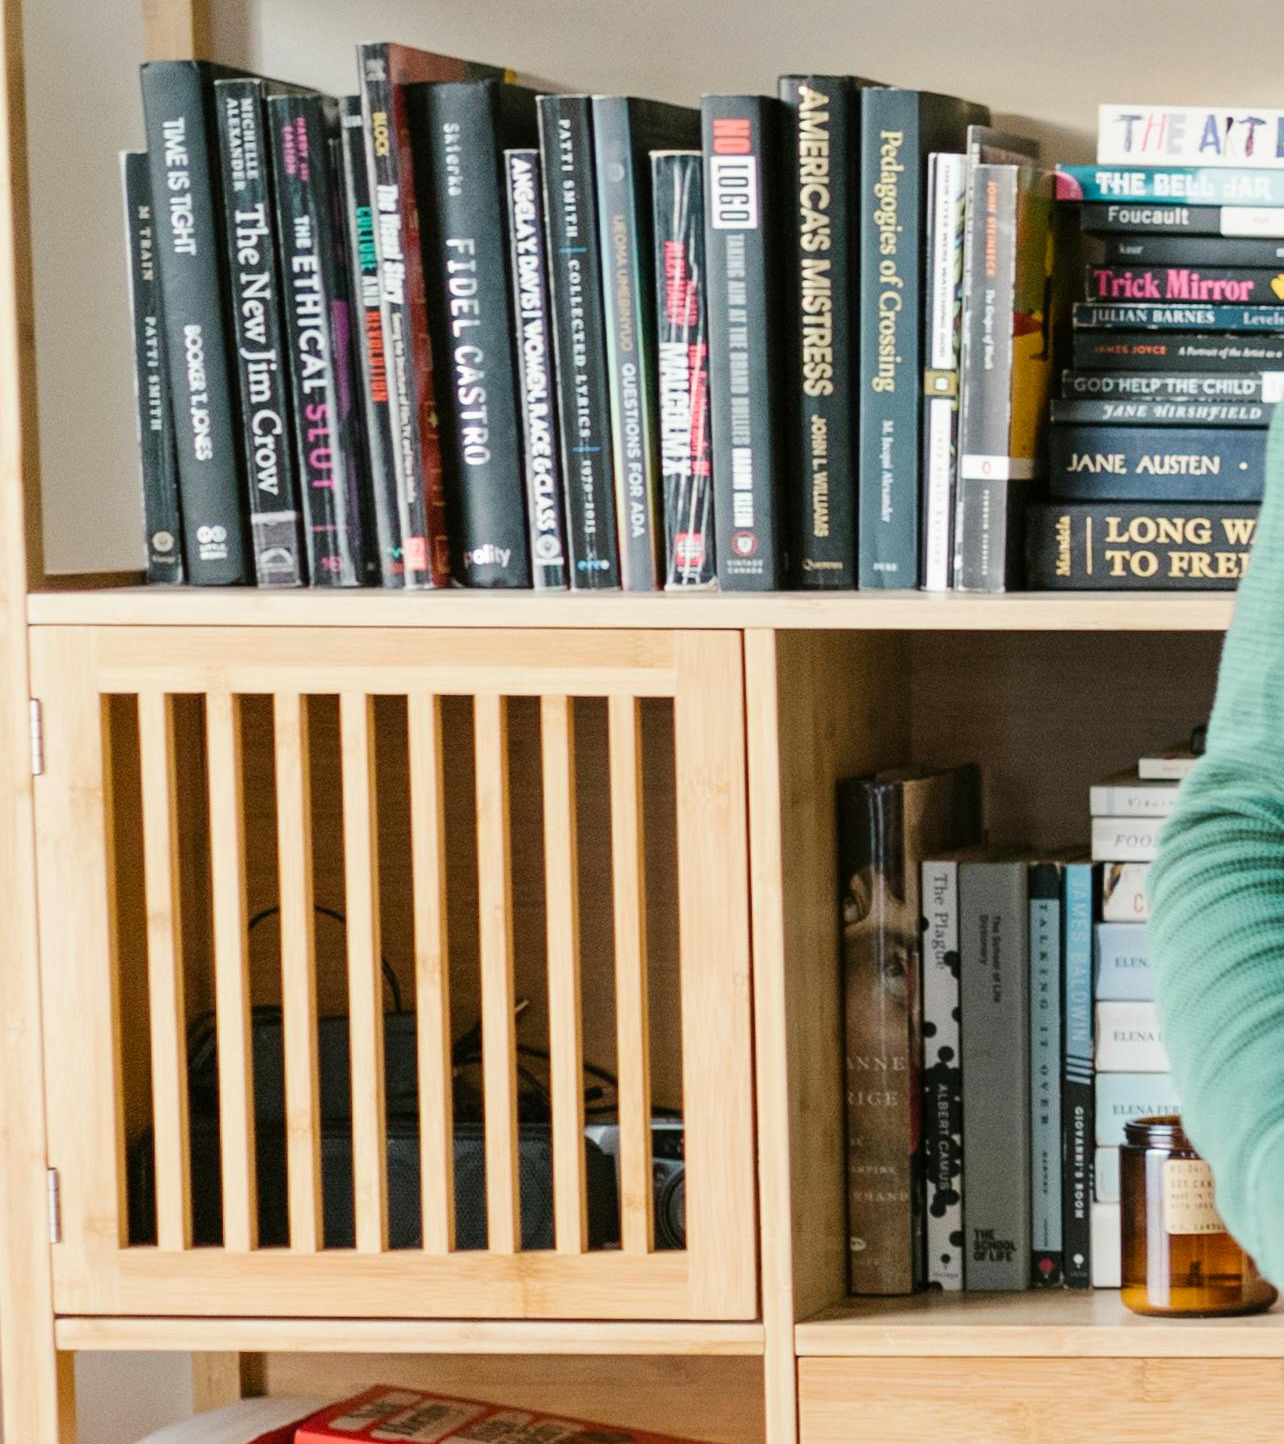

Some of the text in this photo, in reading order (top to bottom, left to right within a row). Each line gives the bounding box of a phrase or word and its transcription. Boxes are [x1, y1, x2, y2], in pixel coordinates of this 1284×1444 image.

[161, 118, 195, 254] TIME IS TIGHT
[226, 97, 245, 192] ALEXANDER
[239, 98, 258, 180] MICHELLE
[712, 119, 750, 223] NO LOGO
[1113, 111, 1187, 155] THE
[1199, 114, 1266, 157] ART
[1095, 172, 1272, 202] THE BELL JAR
[1108, 206, 1189, 226] Foucault
[797, 86, 833, 537] AMERICA'S MISTRESS JOHN L. WILLIAMS
[872, 130, 904, 392] Pedagogies of Crossing
[1094, 270, 1254, 301] Trick Mirror
[234, 204, 281, 496] The New Jim Crow
[290, 215, 333, 491] THE ETHICAL SLUT
[444, 239, 490, 464] FIDEL CASTRO
[1092, 308, 1214, 324] JULIAN BARNES
[183, 325, 212, 460] BOOKER T. JONES
[657, 342, 689, 476] MALCOLM X
[1074, 376, 1255, 395] GOD HELP THE CHILD
[620, 363, 645, 537] QUESTIONS FOR ADA
[1066, 455, 1219, 475] JANE AUSTEN
[1104, 517, 1212, 545] LONG
[1104, 551, 1157, 577] TO
[936, 1084, 949, 1191] ALBERT CAMUS
[1071, 1106, 1085, 1218] GIOVANNI'S ROOM
